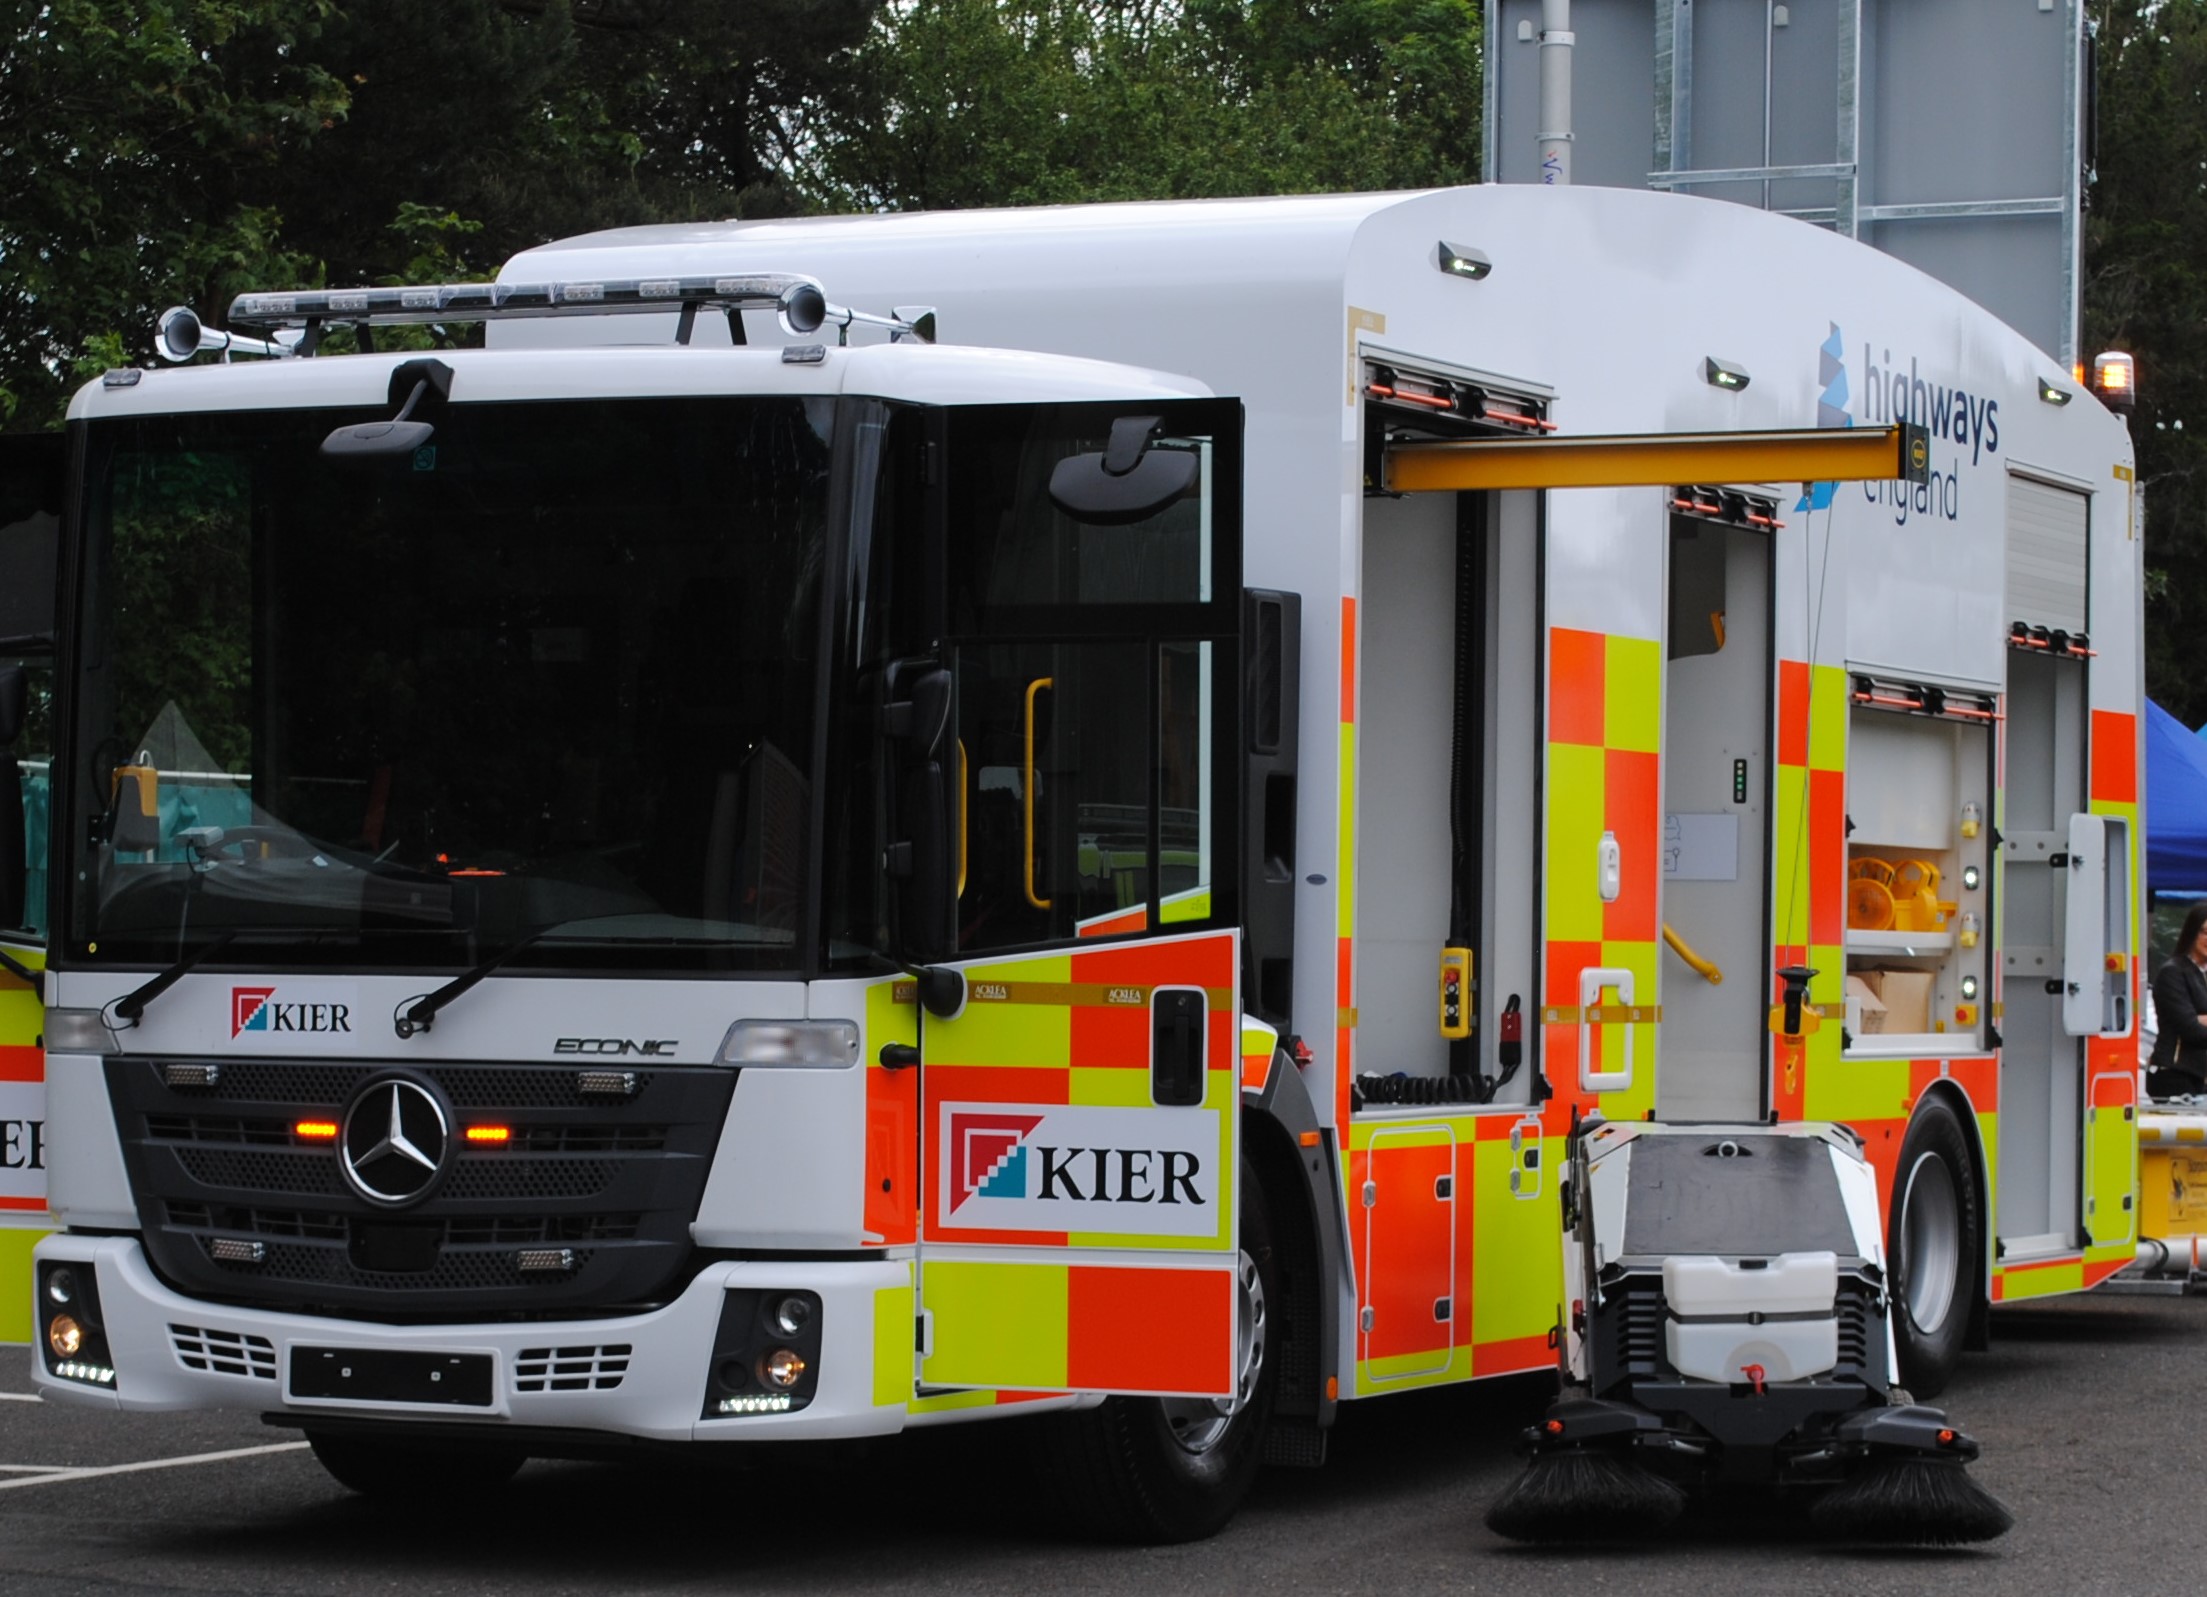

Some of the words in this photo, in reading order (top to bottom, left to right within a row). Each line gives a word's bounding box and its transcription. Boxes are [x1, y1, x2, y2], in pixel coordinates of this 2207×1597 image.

[1864, 342, 1998, 467] highways
[273, 1003, 351, 1032] KIER
[553, 1038, 679, 1056] ECONIC
[1036, 1146, 1206, 1205] KIER
